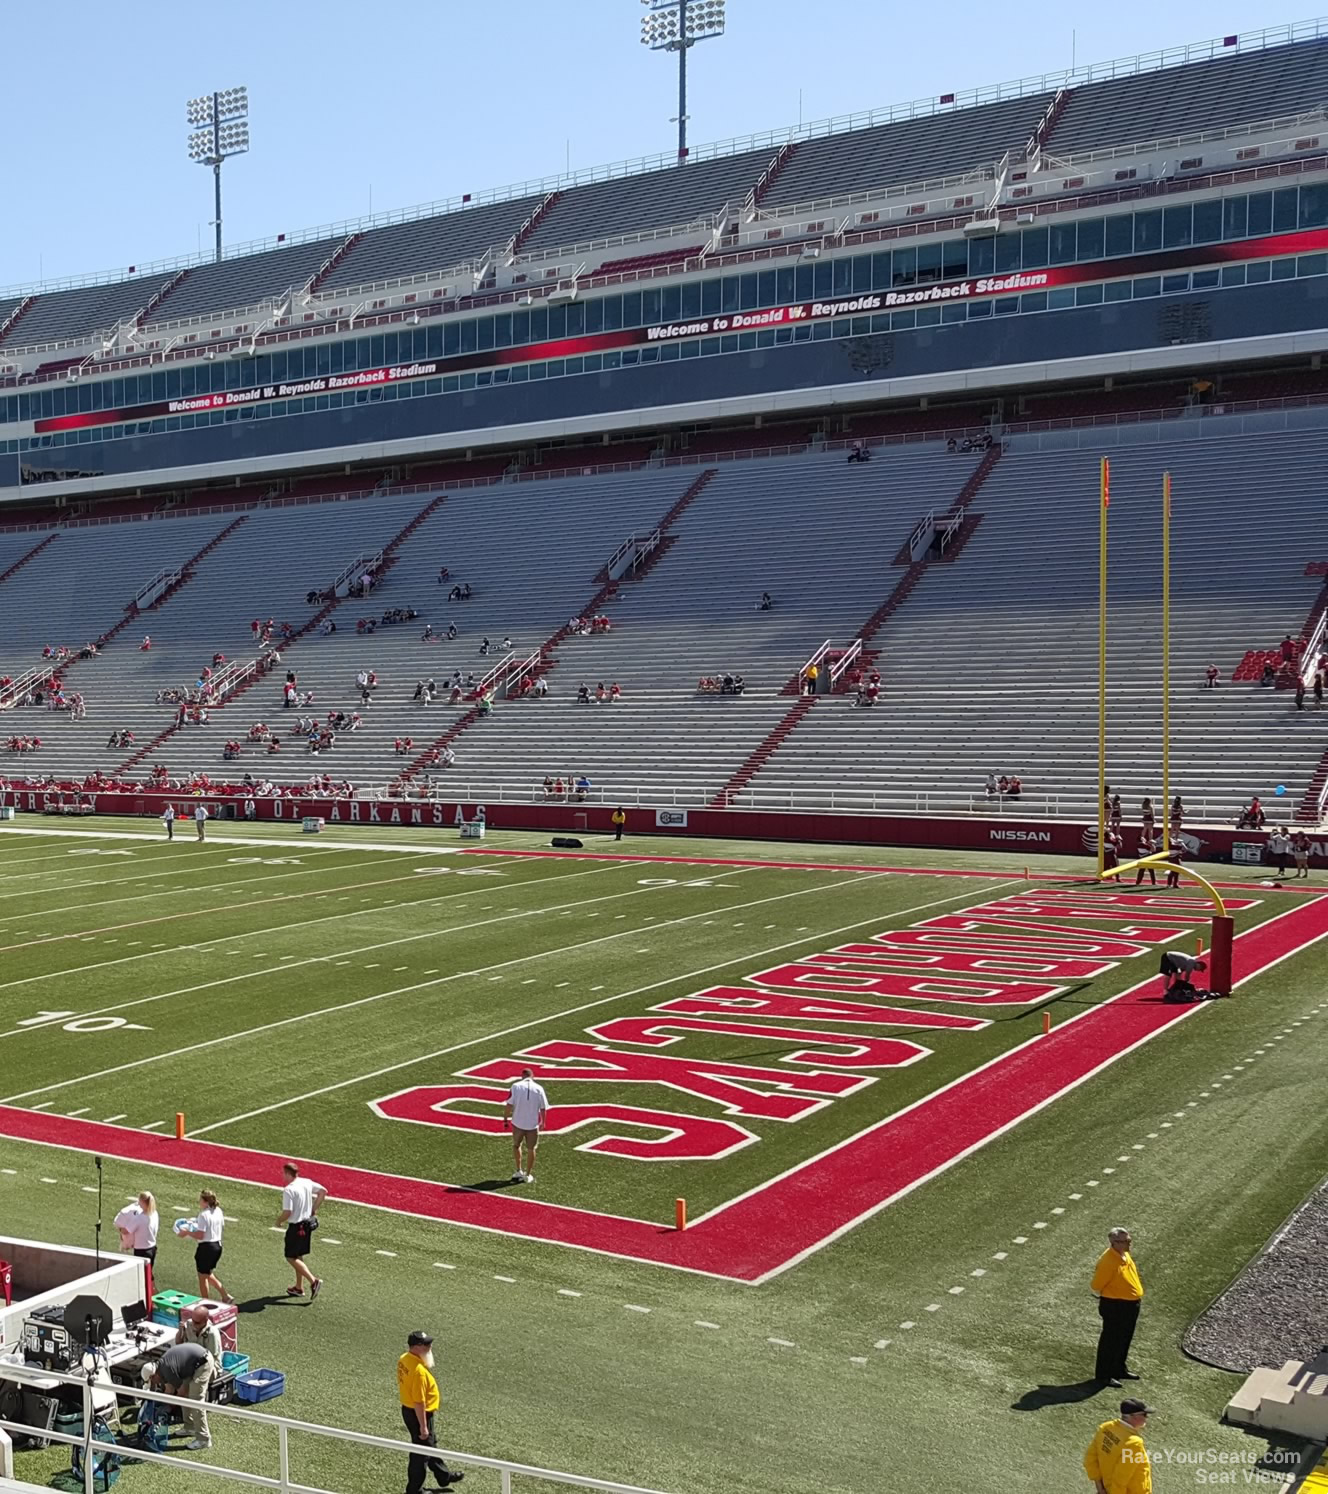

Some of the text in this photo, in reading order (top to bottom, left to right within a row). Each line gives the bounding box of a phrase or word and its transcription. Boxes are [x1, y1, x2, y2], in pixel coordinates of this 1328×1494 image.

[647, 273, 1048, 340] Welcome to Donald W. Reynolds Razorback Stadium
[168, 362, 437, 411] Welcome to Donald W. Reynolds Razorback Stadium
[273, 799, 487, 825] OF ARKANSAS
[989, 830, 1051, 842] NISSAN
[16, 1010, 128, 1033] 10
[367, 888, 1266, 1162] RAZORBACKS
